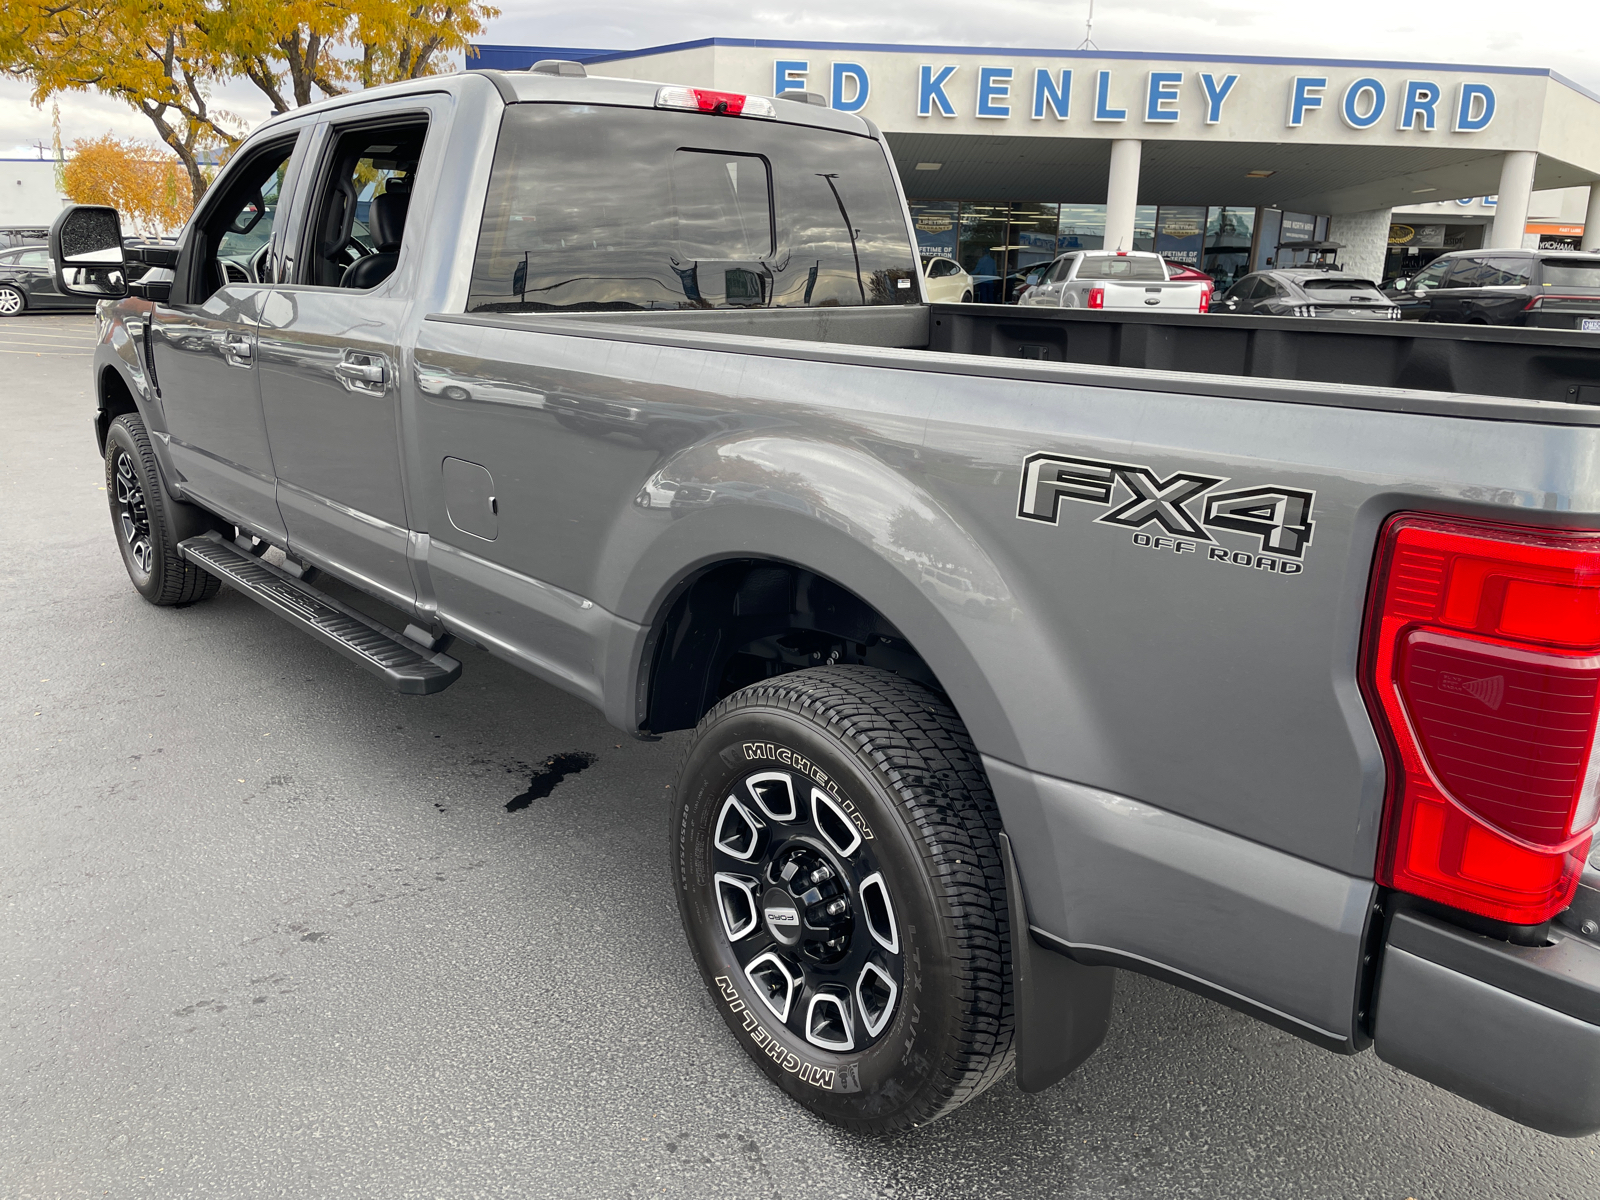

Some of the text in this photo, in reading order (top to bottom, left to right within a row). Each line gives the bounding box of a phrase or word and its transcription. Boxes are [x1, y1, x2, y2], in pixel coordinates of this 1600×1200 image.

[774, 59, 1498, 133] ED KENLEY FORD
[1015, 450, 1317, 560] FX4
[1132, 532, 1304, 575] OFF ROAD
[742, 743, 874, 840] MICHELIN
[767, 913, 794, 921] FORD
[715, 975, 836, 1090] MICHELIN
